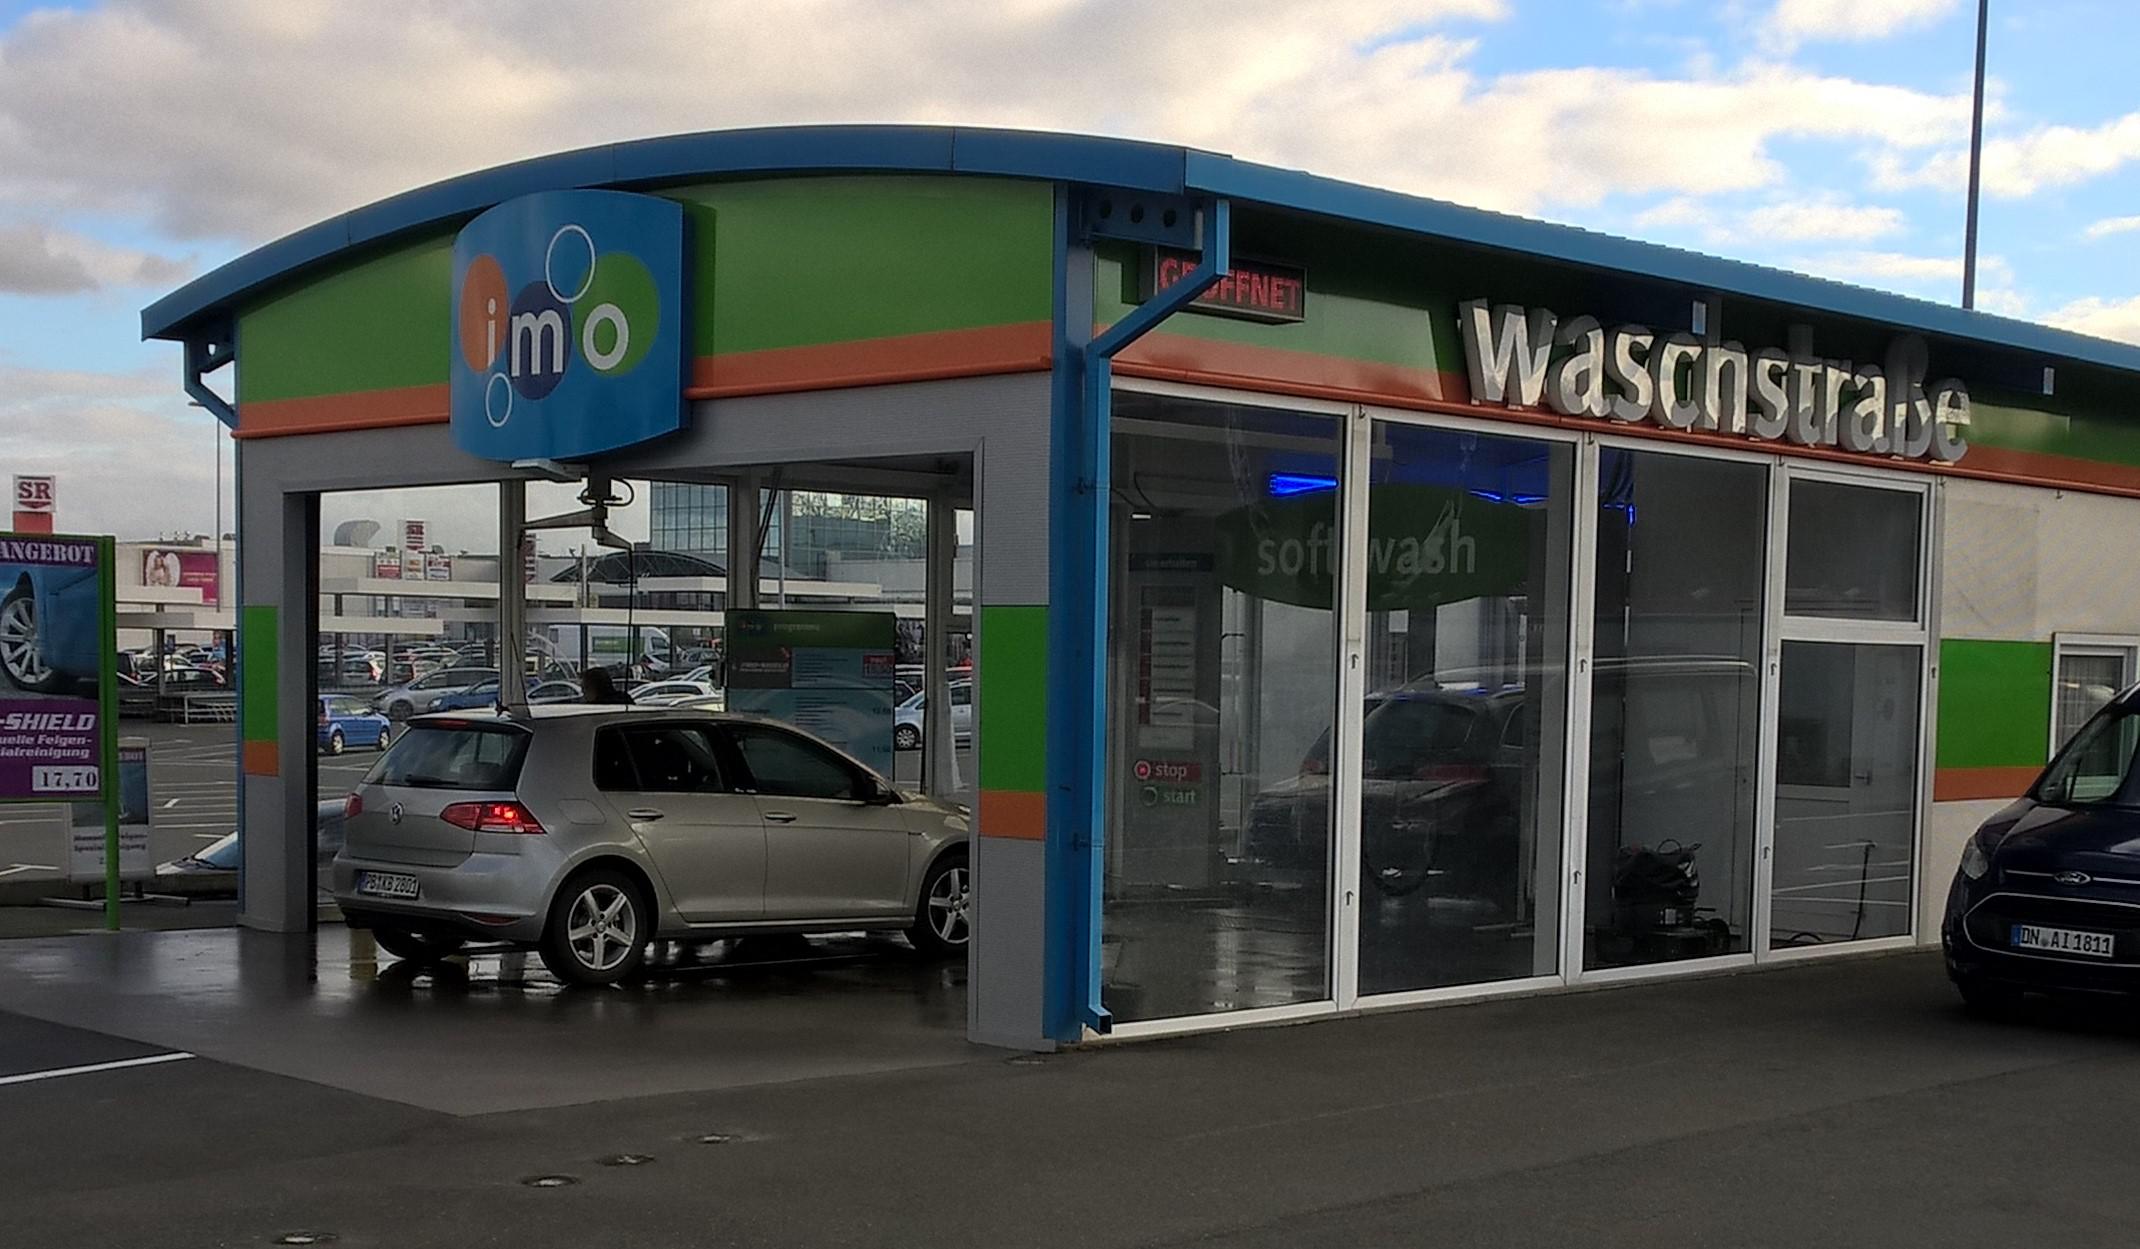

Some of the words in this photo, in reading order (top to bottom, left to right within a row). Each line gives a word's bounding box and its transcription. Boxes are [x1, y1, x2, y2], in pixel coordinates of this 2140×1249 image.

[487, 298, 630, 378] imo
[1459, 297, 1971, 463] waschstraße
[18, 481, 52, 499] SR
[42, 772, 97, 788] 17,70
[1154, 762, 1188, 782] stop
[1163, 789, 1197, 804] start
[2021, 926, 2040, 946] DN
[2073, 933, 2111, 955] 1811
